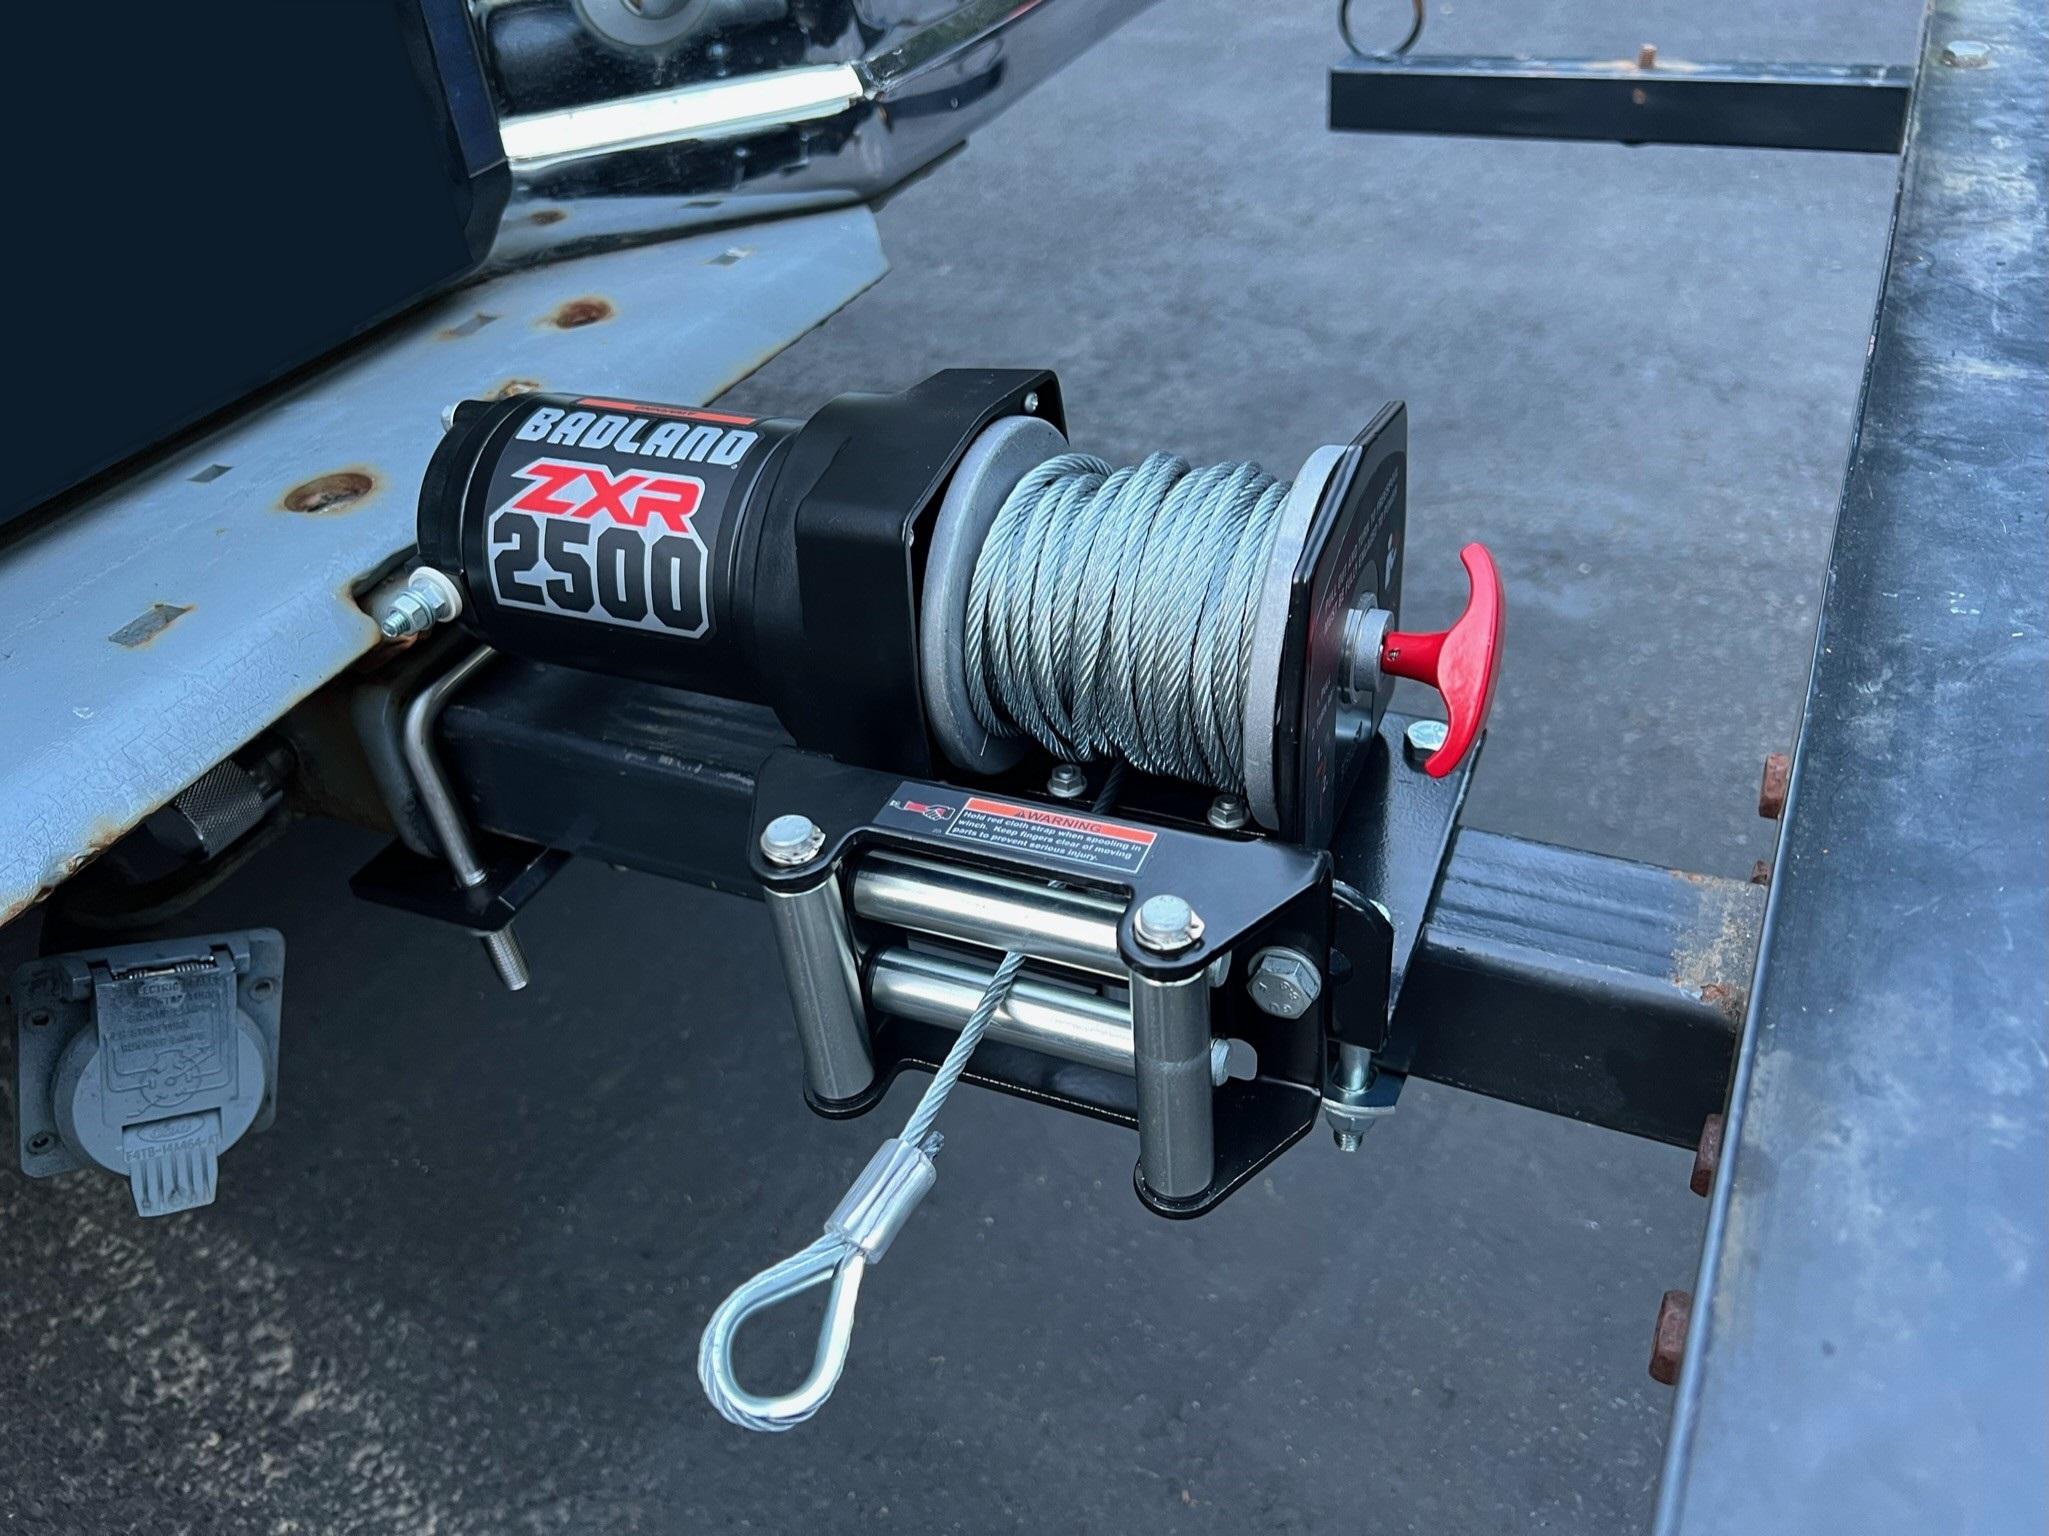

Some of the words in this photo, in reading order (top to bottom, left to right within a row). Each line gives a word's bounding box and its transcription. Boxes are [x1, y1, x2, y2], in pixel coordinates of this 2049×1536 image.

[514, 406, 759, 467] BADLAND
[511, 458, 705, 534] ZXR
[493, 510, 705, 633] 2500
[958, 820, 988, 831] winch.
[993, 825, 1018, 836] Keep
[1020, 829, 1054, 844] fingers
[1056, 838, 1080, 848] clear
[1082, 843, 1093, 851] of
[1094, 846, 1132, 860] moving
[963, 811, 986, 821] Hold
[987, 815, 1004, 824] red
[1004, 818, 1029, 830] cloth
[1030, 822, 1056, 836] strap
[1058, 830, 1084, 841] when
[1085, 836, 1130, 851] spooling
[1131, 843, 1142, 853] in
[1028, 811, 1101, 832] WARNING
[951, 826, 977, 837] parts
[979, 831, 990, 839] to
[990, 833, 1028, 847] prevent
[1029, 841, 1067, 855] serious
[1067, 848, 1098, 861] injury.
